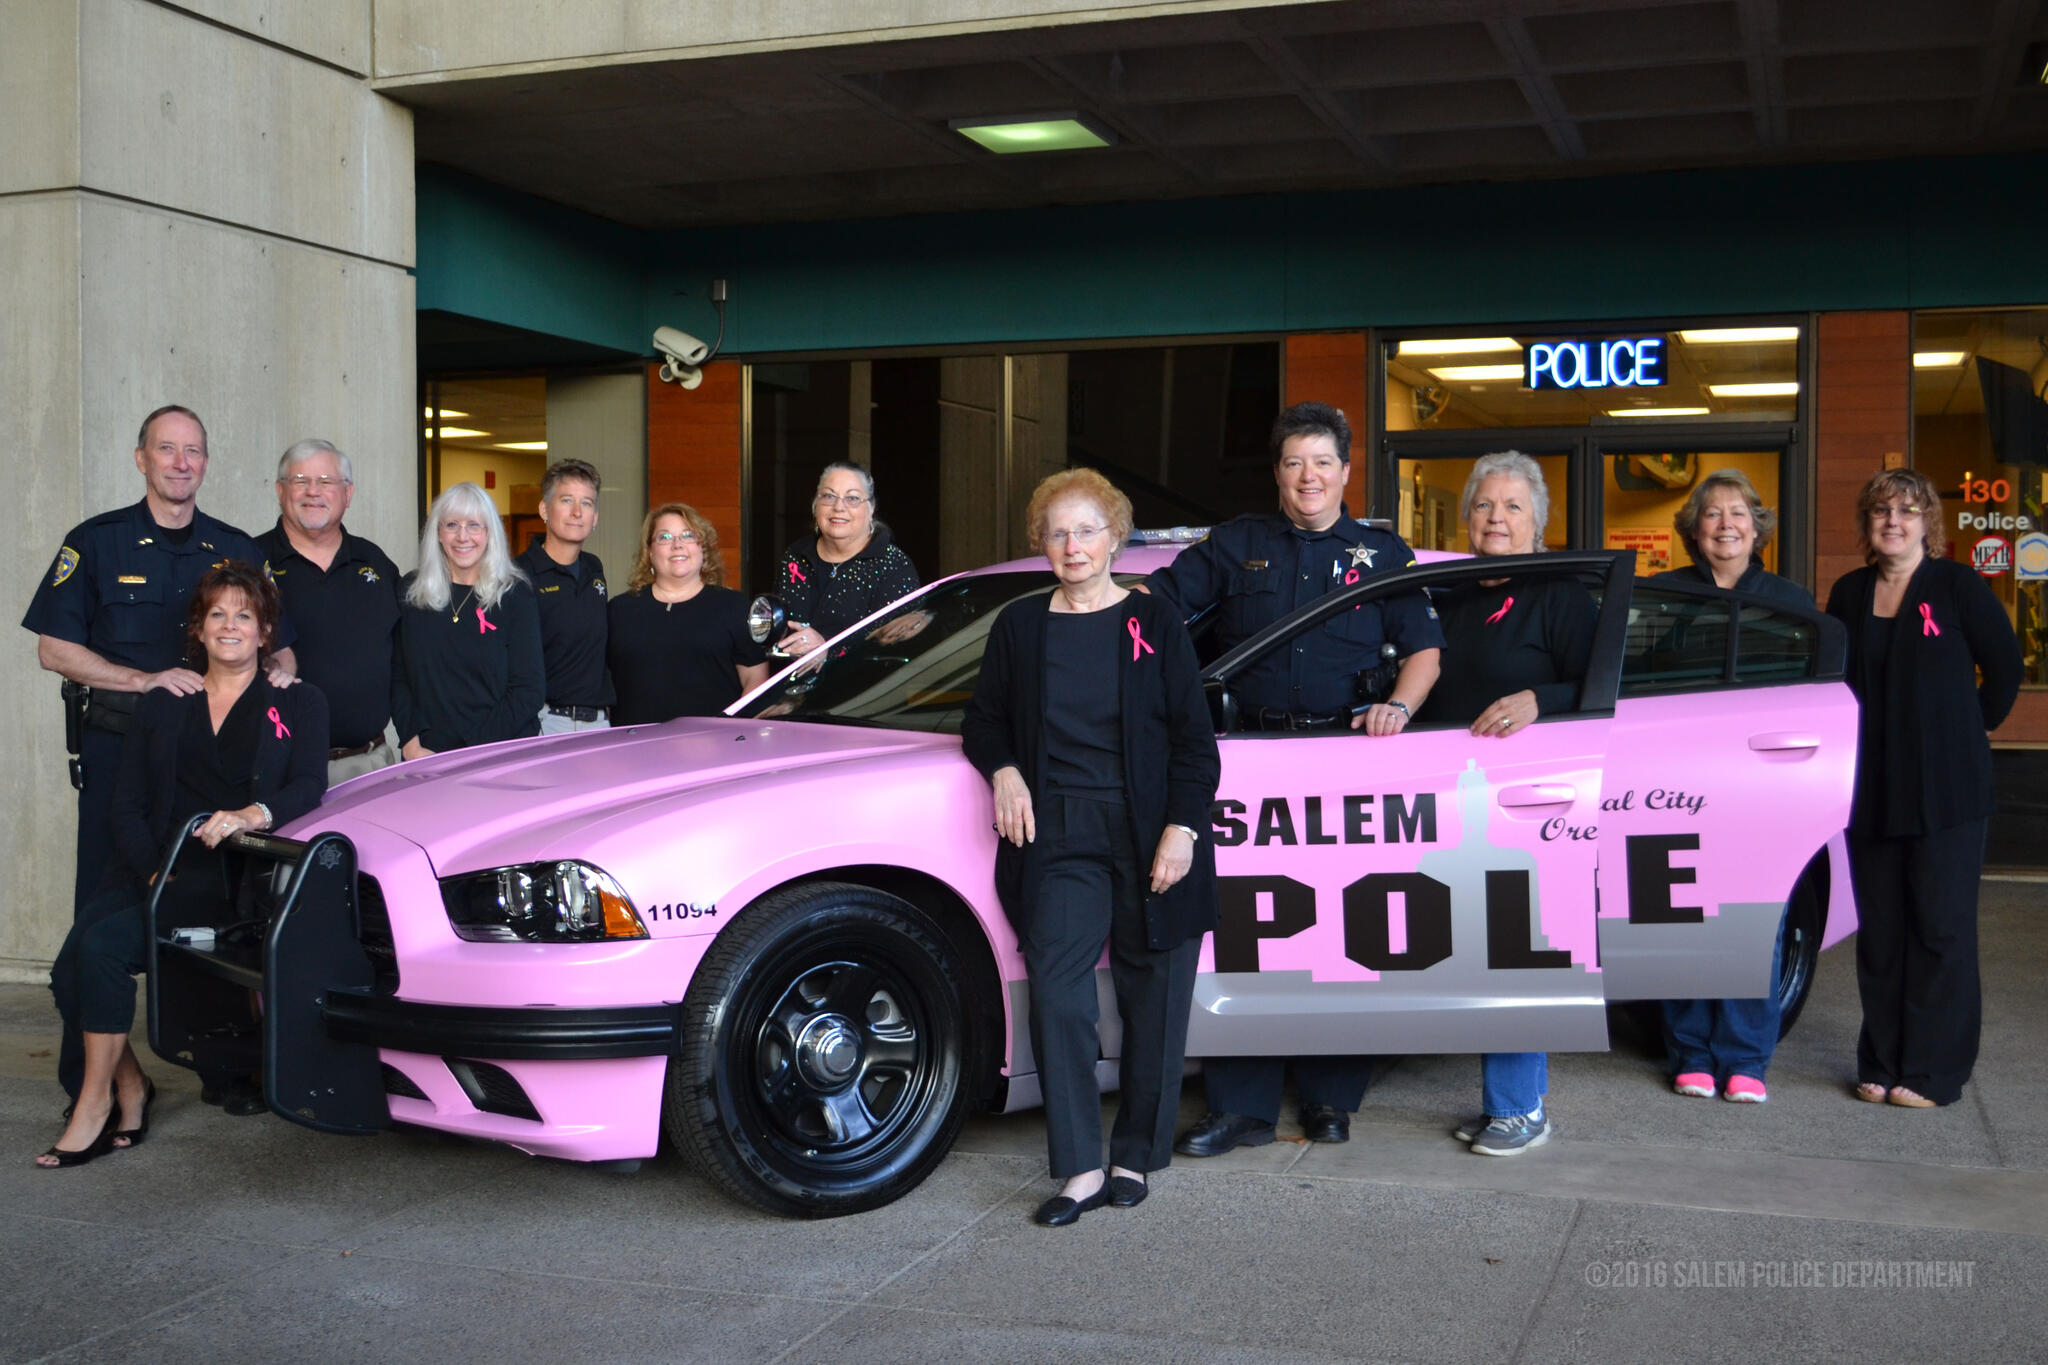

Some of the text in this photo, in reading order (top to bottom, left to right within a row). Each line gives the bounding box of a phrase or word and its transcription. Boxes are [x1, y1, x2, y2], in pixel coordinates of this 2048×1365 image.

[1529, 338, 1661, 389] POLICE
[1959, 479, 2011, 503] 130
[1958, 512, 2030, 531] Police
[1974, 545, 2010, 564] METH
[1645, 788, 1708, 816] City
[1211, 793, 1438, 847] SALEM
[647, 901, 718, 921] 11094
